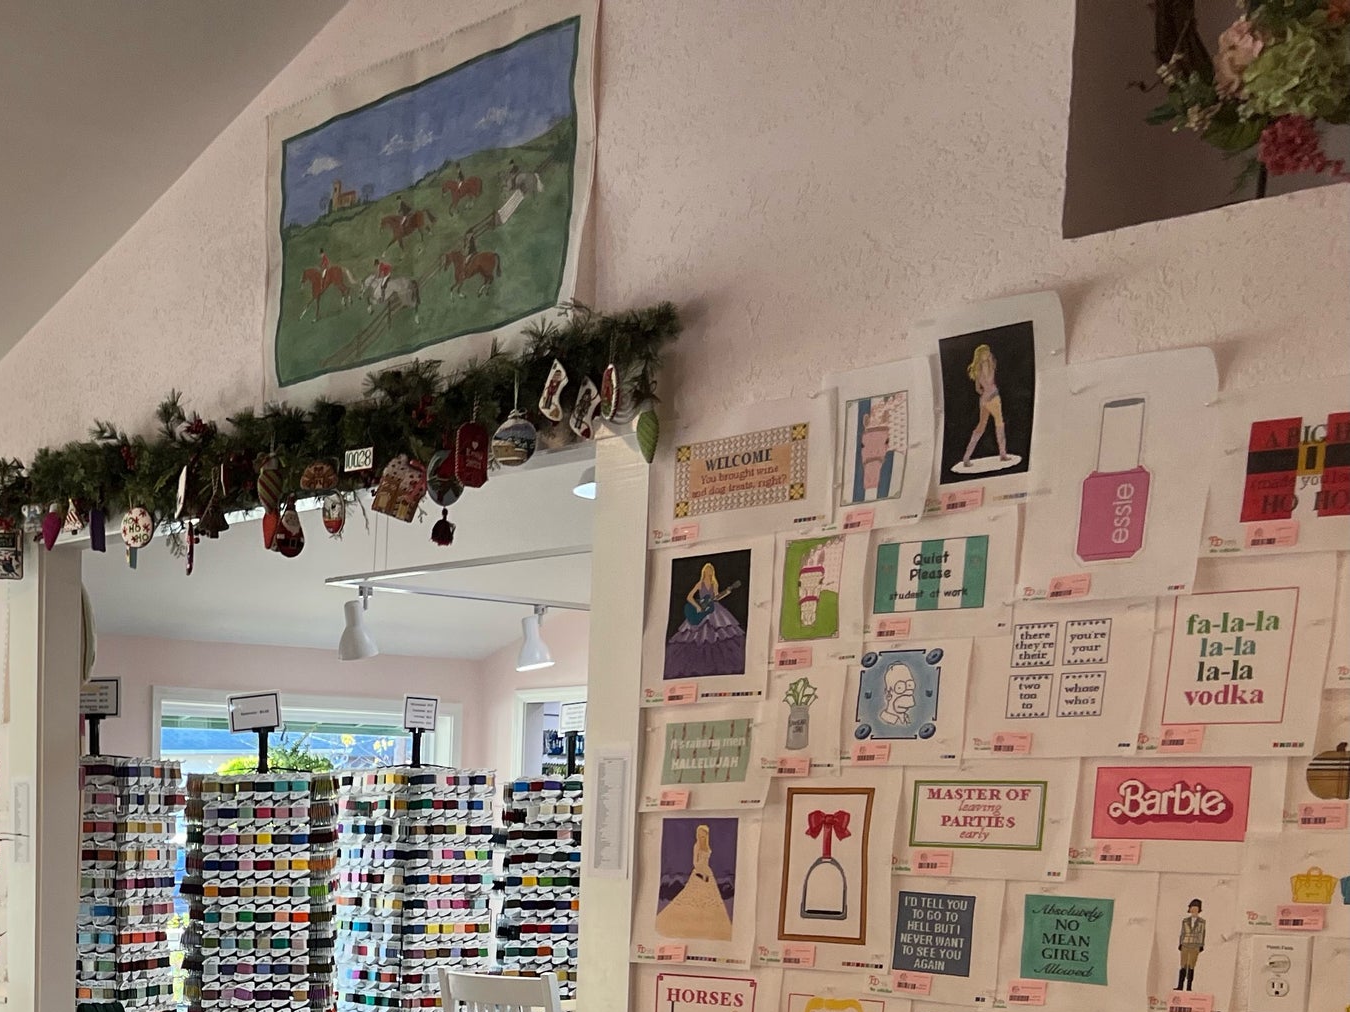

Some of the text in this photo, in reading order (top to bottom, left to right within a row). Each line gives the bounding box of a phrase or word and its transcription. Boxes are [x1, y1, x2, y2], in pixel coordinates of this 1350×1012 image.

[1289, 424, 1327, 445] BIG
[345, 449, 371, 469] 10028
[705, 448, 773, 471] WELCOME
[701, 465, 779, 485] You brought wine
[691, 474, 787, 498] and dog treats, right?
[1261, 494, 1299, 514] HO
[1112, 482, 1135, 544] essie
[912, 551, 949, 566] Quiet
[909, 567, 951, 581] Please
[889, 587, 968, 601] student at work
[1186, 610, 1281, 635] fa-la-la
[1019, 631, 1051, 640] there
[1069, 630, 1107, 642] you're
[1015, 640, 1055, 651] they're
[1072, 643, 1101, 655] your
[1200, 636, 1257, 657] la-la
[1019, 650, 1048, 661] their
[1196, 660, 1254, 682] la-la
[1018, 682, 1041, 691] two
[1064, 684, 1100, 694] whose
[1019, 692, 1037, 701] too
[1064, 696, 1096, 706] who's
[1184, 684, 1265, 706] vodka
[1021, 701, 1033, 710] to
[723, 737, 746, 747] men
[671, 756, 739, 771] HALLELUJAH
[927, 788, 1032, 800] MASTER OF
[1109, 779, 1227, 819] Barbie
[958, 800, 1002, 816] leaving
[940, 815, 1016, 828] PARTIES
[959, 827, 990, 842] early
[904, 895, 968, 911] I'D TELL YOU
[912, 908, 958, 922] TO GO TO
[1032, 903, 1104, 922] Absolutely
[907, 920, 961, 935] HELL BUT I
[1055, 918, 1080, 931] NO
[900, 932, 965, 948] NEVER WANT
[1041, 932, 1090, 947] MEAN
[902, 944, 962, 960] TO SEE YOU
[1041, 947, 1090, 962] GIRLS
[914, 958, 945, 971] AGAIN
[1033, 962, 1095, 977] Allowed
[666, 987, 745, 1008] HORSES
